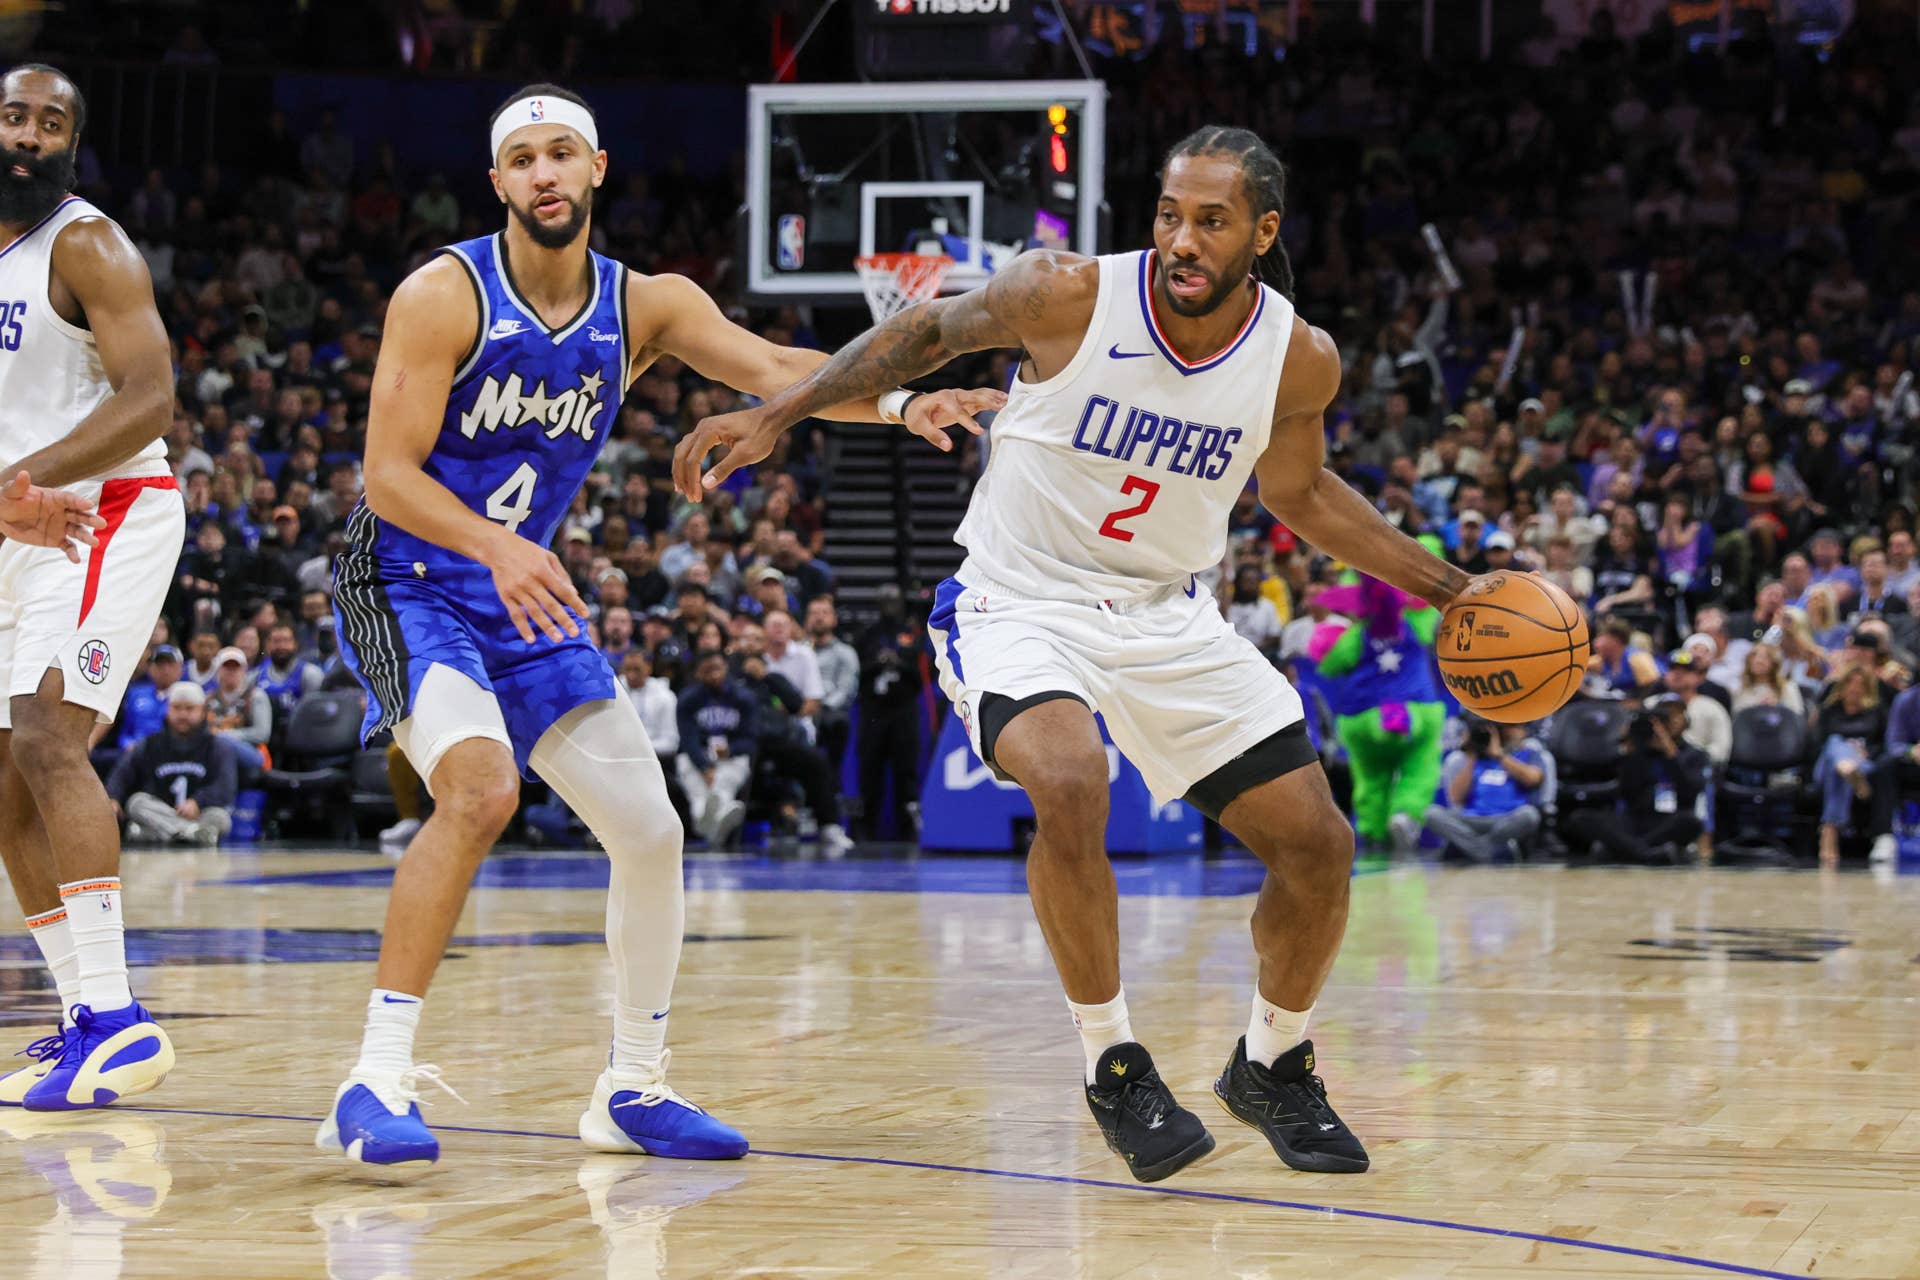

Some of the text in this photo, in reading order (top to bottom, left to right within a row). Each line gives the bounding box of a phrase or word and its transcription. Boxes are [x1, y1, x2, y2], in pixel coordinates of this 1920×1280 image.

[494, 318, 522, 333] NIKE
[587, 325, 619, 346] Disney
[1071, 394, 1243, 481] CLIPPERS
[485, 461, 538, 533] 4
[1098, 474, 1161, 543] 2
